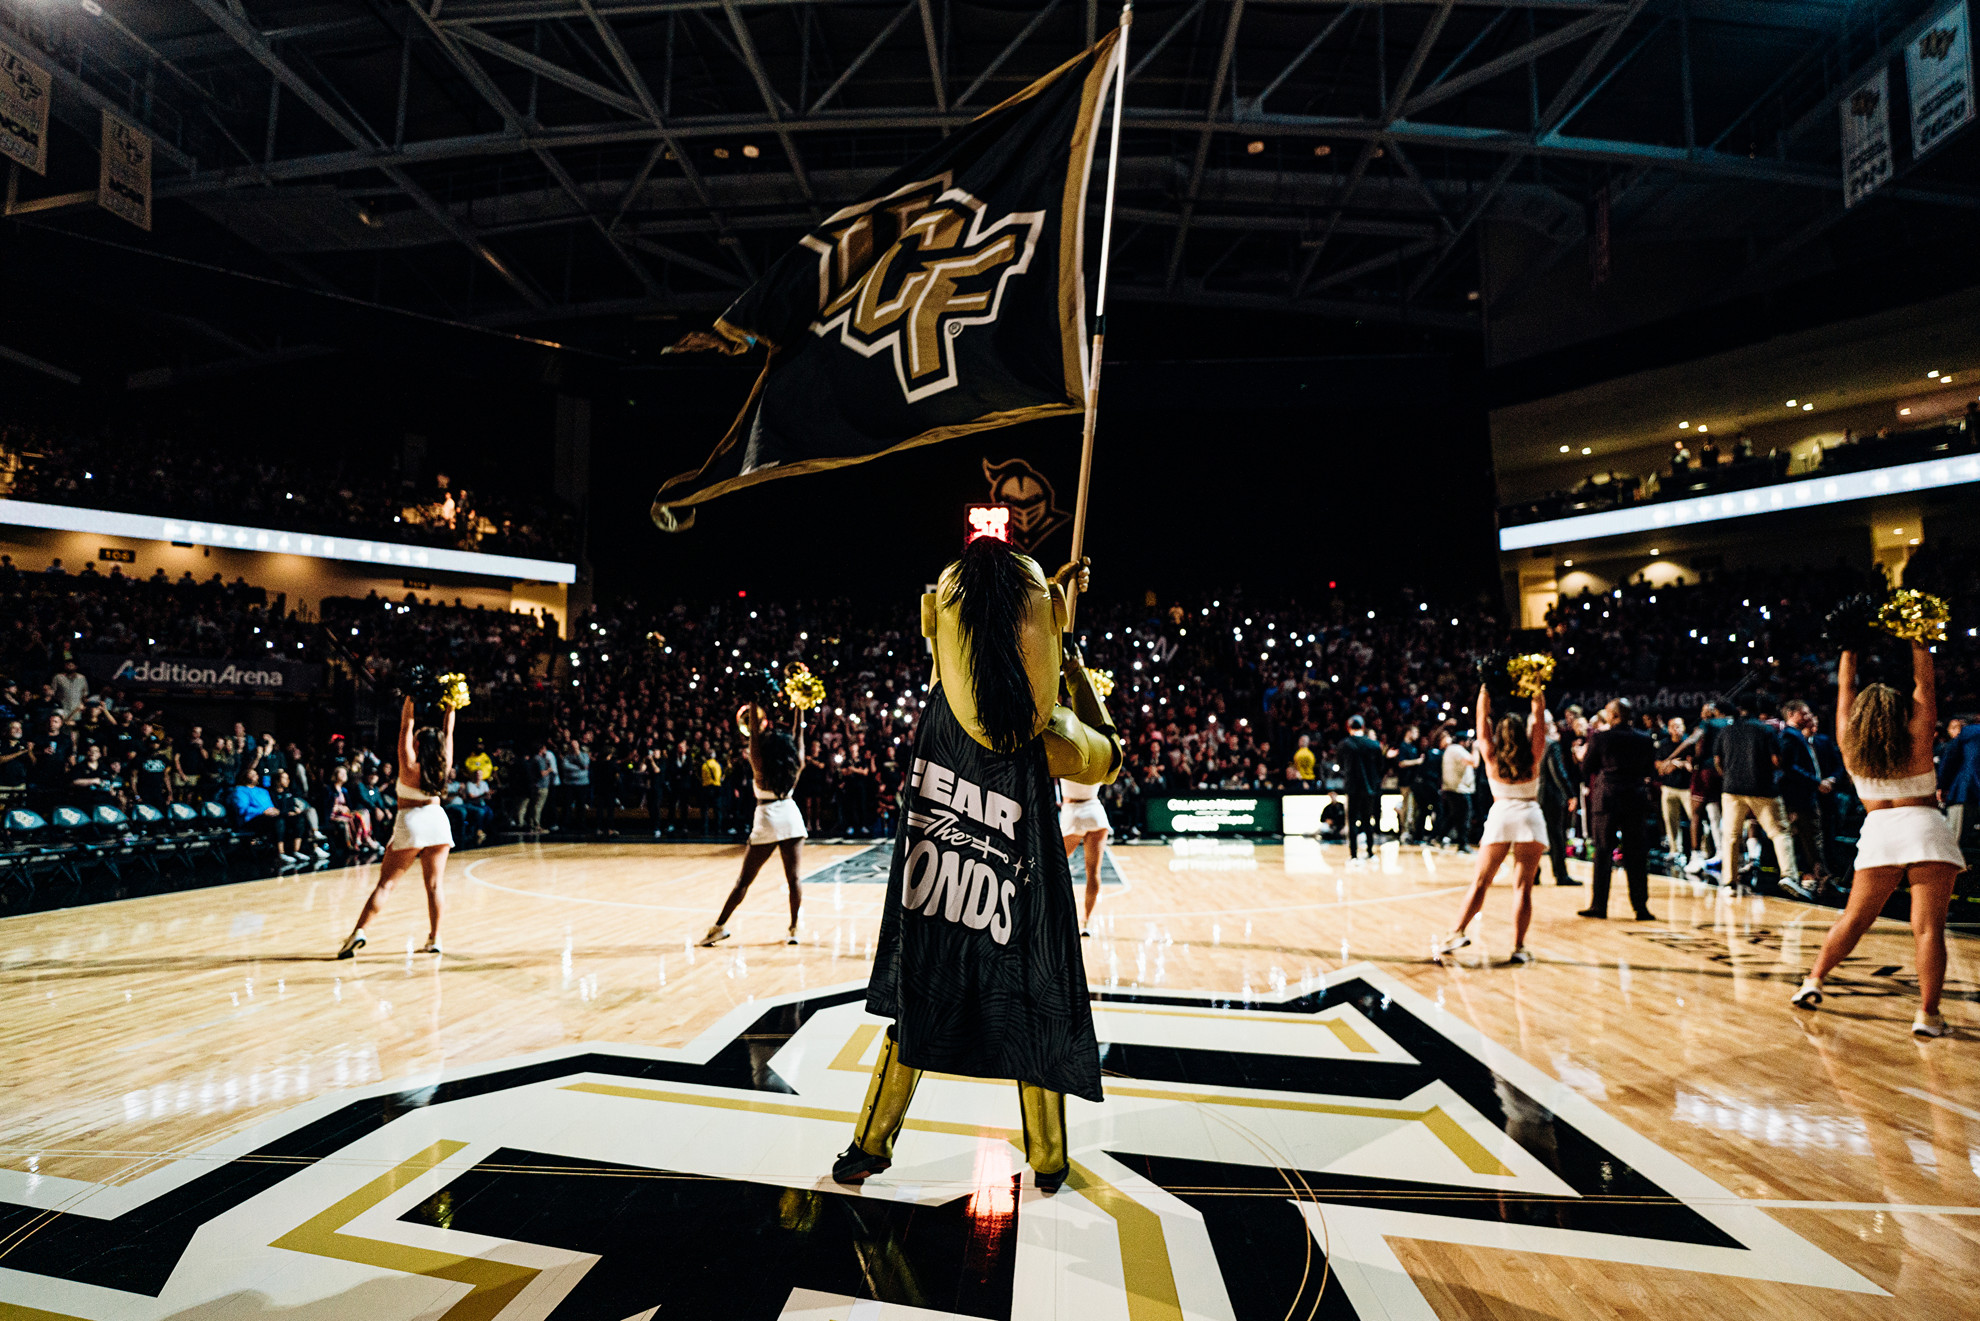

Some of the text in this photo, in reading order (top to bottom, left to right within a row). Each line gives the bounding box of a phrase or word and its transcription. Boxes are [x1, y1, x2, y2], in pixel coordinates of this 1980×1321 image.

[802, 172, 1045, 403] UCF
[924, 808, 973, 846] The
[902, 836, 1016, 946] ONDS
